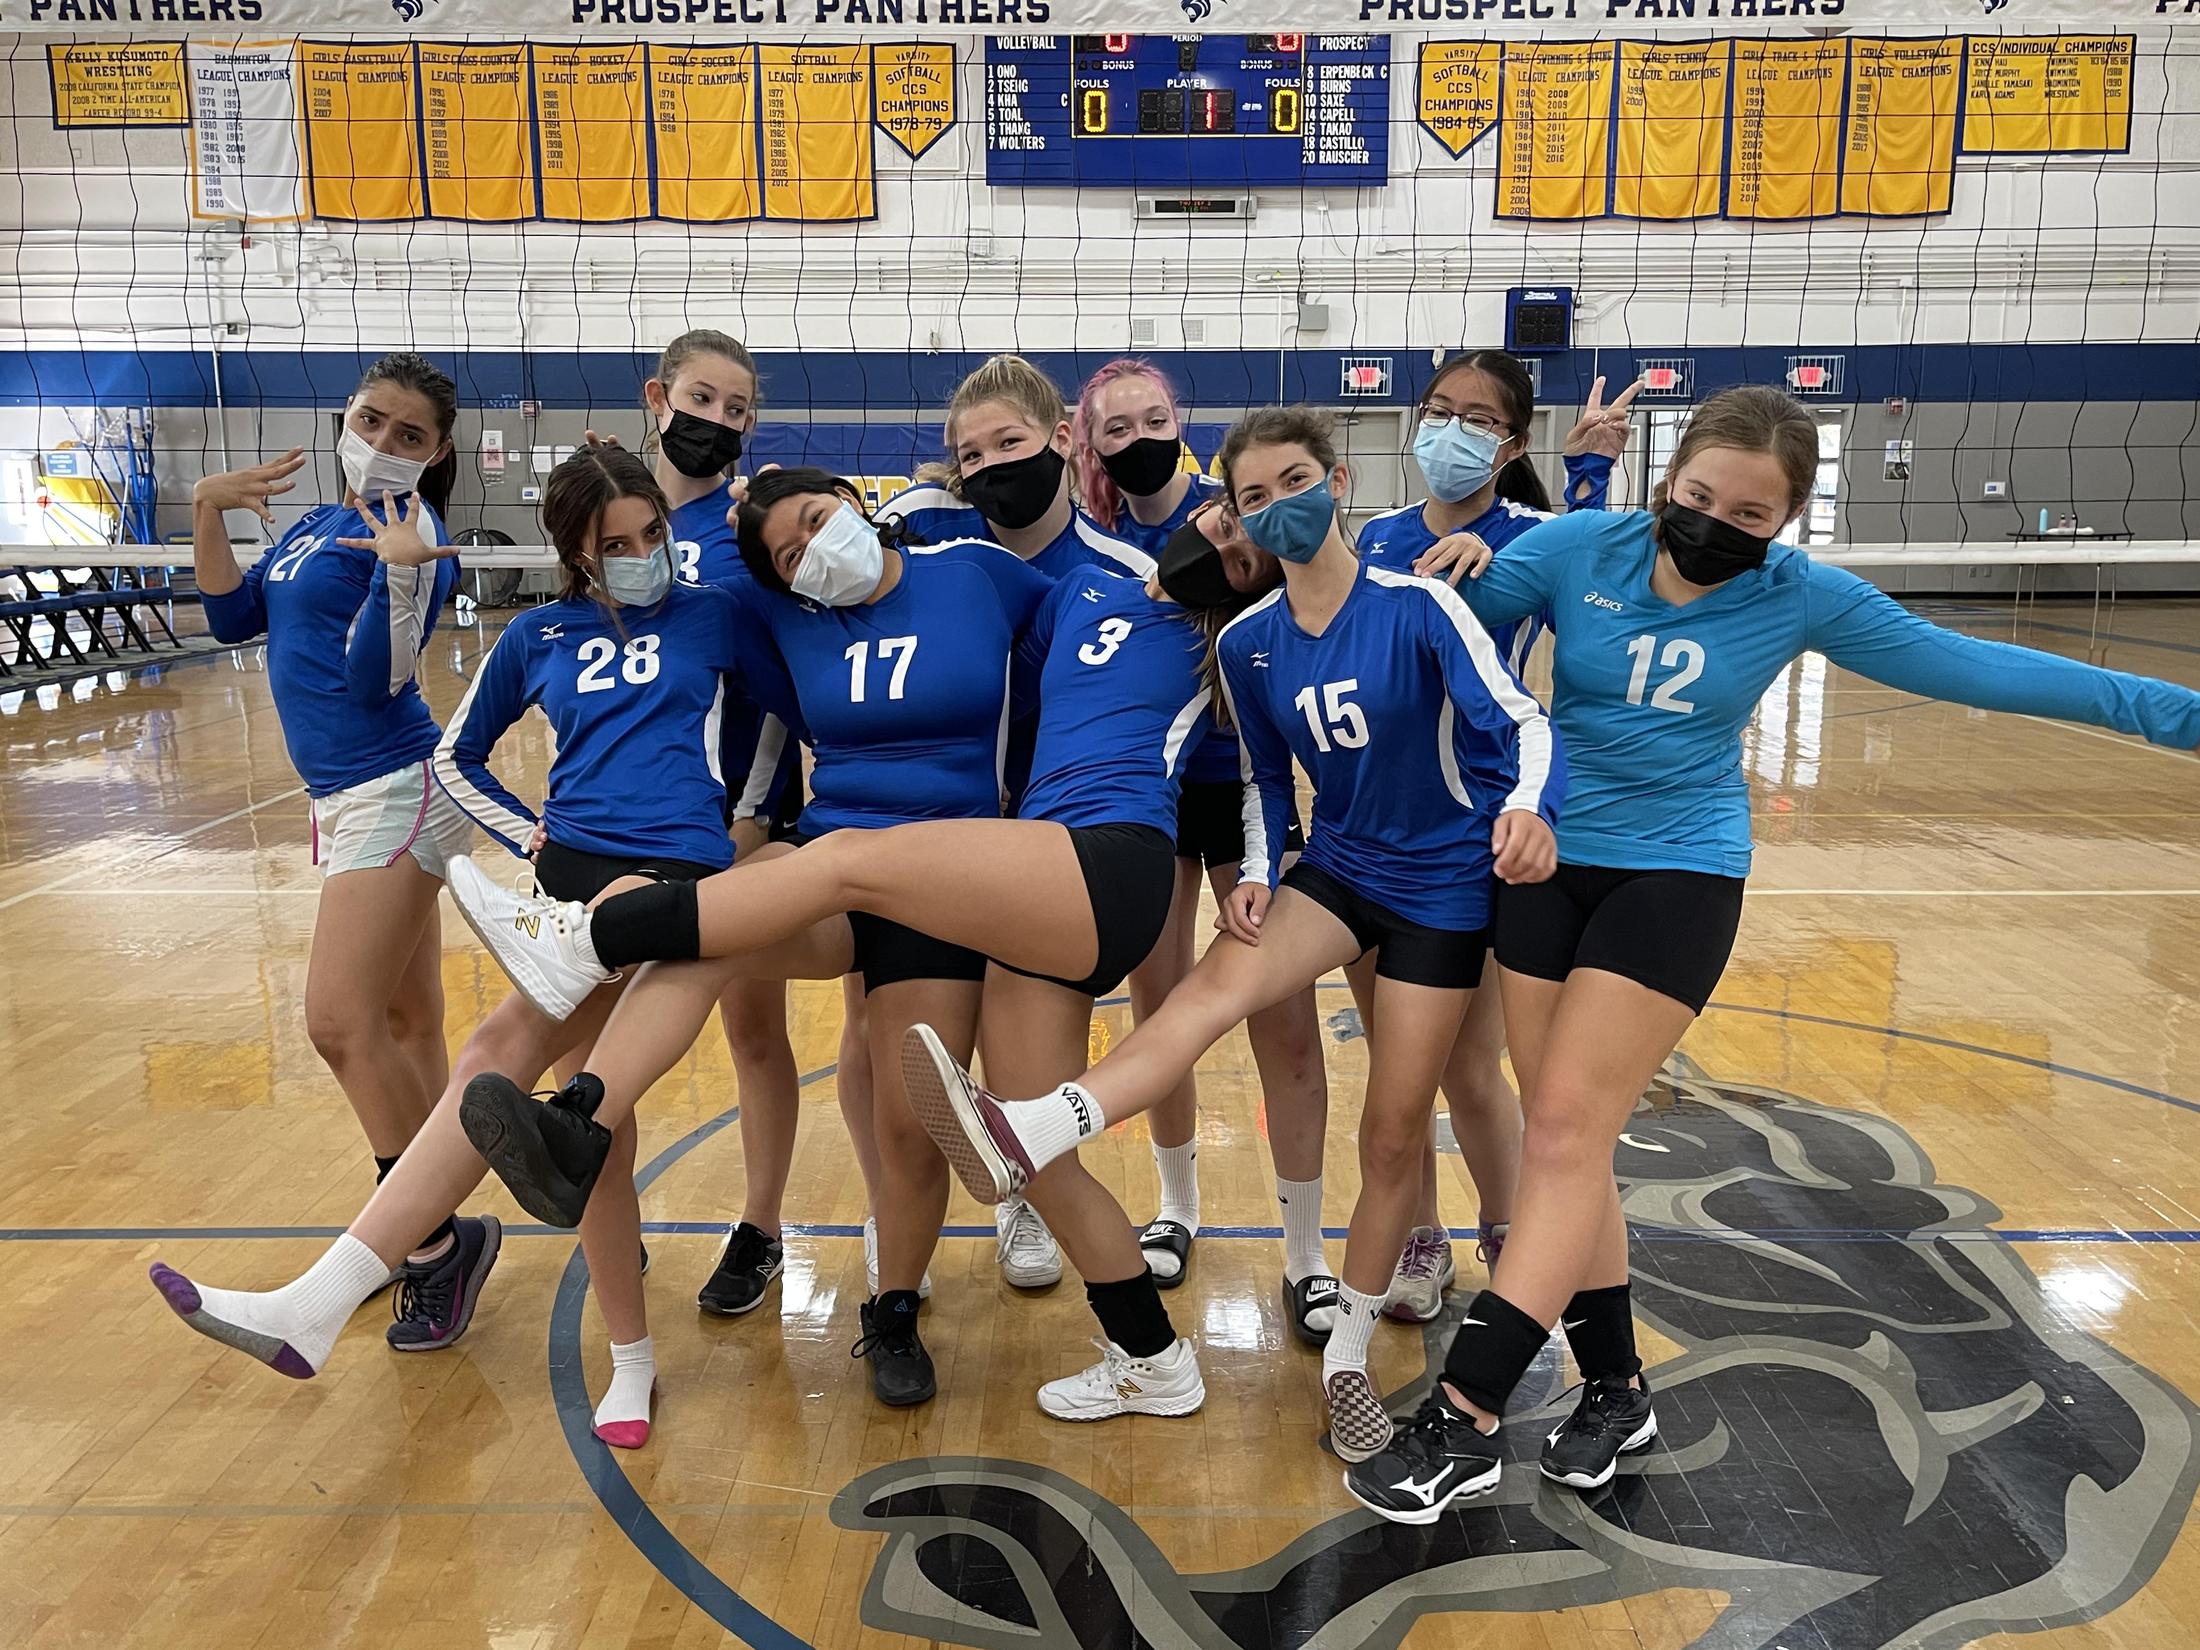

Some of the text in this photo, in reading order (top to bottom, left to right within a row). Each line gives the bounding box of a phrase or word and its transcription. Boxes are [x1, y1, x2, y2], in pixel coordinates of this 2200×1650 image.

[30, 0, 262, 21] PANTHERS
[572, 0, 1050, 23] PROSPECT PANTHERS
[1359, 0, 1576, 20] PROSPECT
[997, 36, 1057, 50] VOLLEYBALL
[1172, 35, 1202, 43] PERIOD
[1320, 36, 1370, 50] PROSPECT
[1894, 47, 1950, 60] VOLLEYBALL
[1972, 42, 2128, 53] CCS INDIVIDUAL CHAMPIONS
[66, 51, 169, 63] KELLY KUSUMOTO
[215, 54, 271, 64] BADMINTON
[345, 54, 401, 65] BASKETBALL
[452, 55, 477, 66] CROSS
[553, 55, 624, 66] FIELD HOCKEY
[702, 56, 736, 67] SOCCER
[791, 55, 838, 65] SOFTBALL
[896, 51, 930, 62] VARSITY
[1536, 54, 1573, 65] SWIMMING
[1773, 49, 1838, 62] TRACK FIELD
[2046, 57, 2078, 66] SWIMMING
[84, 66, 152, 77] WRESTLING
[987, 65, 1017, 78] 1 ONO
[1102, 61, 1135, 70] BONUS
[1240, 60, 1273, 70] BONUS
[1860, 64, 1952, 78] LEAGUE CHAMPIONS
[197, 69, 291, 82] LEAGUE CHAMPIONS
[312, 70, 407, 83] LEAGUE CHAMPIONS
[431, 71, 519, 84] LEAGUE CHAMPIONS
[542, 72, 637, 84] LEAGUE CHAMPIONS
[658, 72, 749, 85] LEAGUE CHAMPIONS
[768, 71, 863, 83] LEAGUE CHAMPIONS
[885, 66, 942, 85] SOFTBALL
[1307, 65, 1388, 79] 8 ERPENBECK C
[1433, 64, 1489, 83] SOFTBALL
[1517, 70, 1600, 83] LEAGUE CHAMPIONS
[1627, 67, 1721, 81] LEAGUE CHAMPIONS
[1746, 68, 1832, 81] LEAGUE CHAMPIONS
[1995, 69, 2020, 77] MURPHY
[2045, 69, 2078, 77] SWIMMING
[79, 82, 119, 91] CALIFORNIA
[122, 82, 143, 90] STATE
[987, 80, 1029, 93] 2 TSENG
[1074, 79, 1110, 88] FOULS
[1167, 78, 1207, 89] PLAYER
[1265, 78, 1300, 88] FOULS
[1307, 80, 1352, 93] 9 BURNS
[1447, 83, 1472, 93] CCS
[2003, 79, 2033, 88] YAMASAKI
[2045, 78, 2080, 87] BADMINTON
[198, 87, 214, 95] 1977
[768, 89, 783, 97] 1977
[902, 84, 927, 95] CCS
[1548, 89, 1568, 98] 2008
[1995, 91, 2015, 99] ADAMS
[2045, 89, 2079, 98] WRESTLING
[100, 96, 117, 104] TIME
[119, 95, 171, 104] ALL-AMERICAN
[987, 93, 1068, 107] 4 KHA C
[1304, 94, 1345, 107] 10 SAXE
[1425, 99, 1493, 111] CHAMPIONS
[1547, 101, 1567, 109] 2009
[882, 100, 949, 113] CHAMPIONS
[1084, 90, 1107, 132] 0
[1205, 91, 1214, 130] 1
[1275, 89, 1298, 132] 0
[769, 109, 785, 118] 1979
[987, 108, 1024, 121] 5 TOAL
[1304, 108, 1356, 121] 14 CAPELL
[890, 117, 942, 131] 1978-79
[988, 122, 1031, 135] 6 THANG
[1304, 122, 1352, 135] 15 TAKAO
[1432, 116, 1485, 129] 1984-85
[1546, 123, 1565, 131] 2011
[201, 132, 218, 140] 1981
[988, 136, 1046, 150] 7 WOLTERS
[1303, 137, 1365, 150] 18 CASTILLO
[1546, 144, 1564, 153] 2015
[1302, 151, 1370, 164] 20 RAUSCHER
[1545, 154, 1564, 162] 2016
[269, 535, 328, 582] 21
[1595, 596, 1624, 612] asics
[1078, 617, 1133, 666] 3
[577, 634, 661, 694] 28
[844, 635, 918, 703] 17
[1625, 634, 1706, 715] 12
[1294, 678, 1370, 753] 15
[1061, 1087, 1091, 1137] VANS
[1146, 1223, 1176, 1235] NIKE
[1310, 1279, 1338, 1293] NIKE
